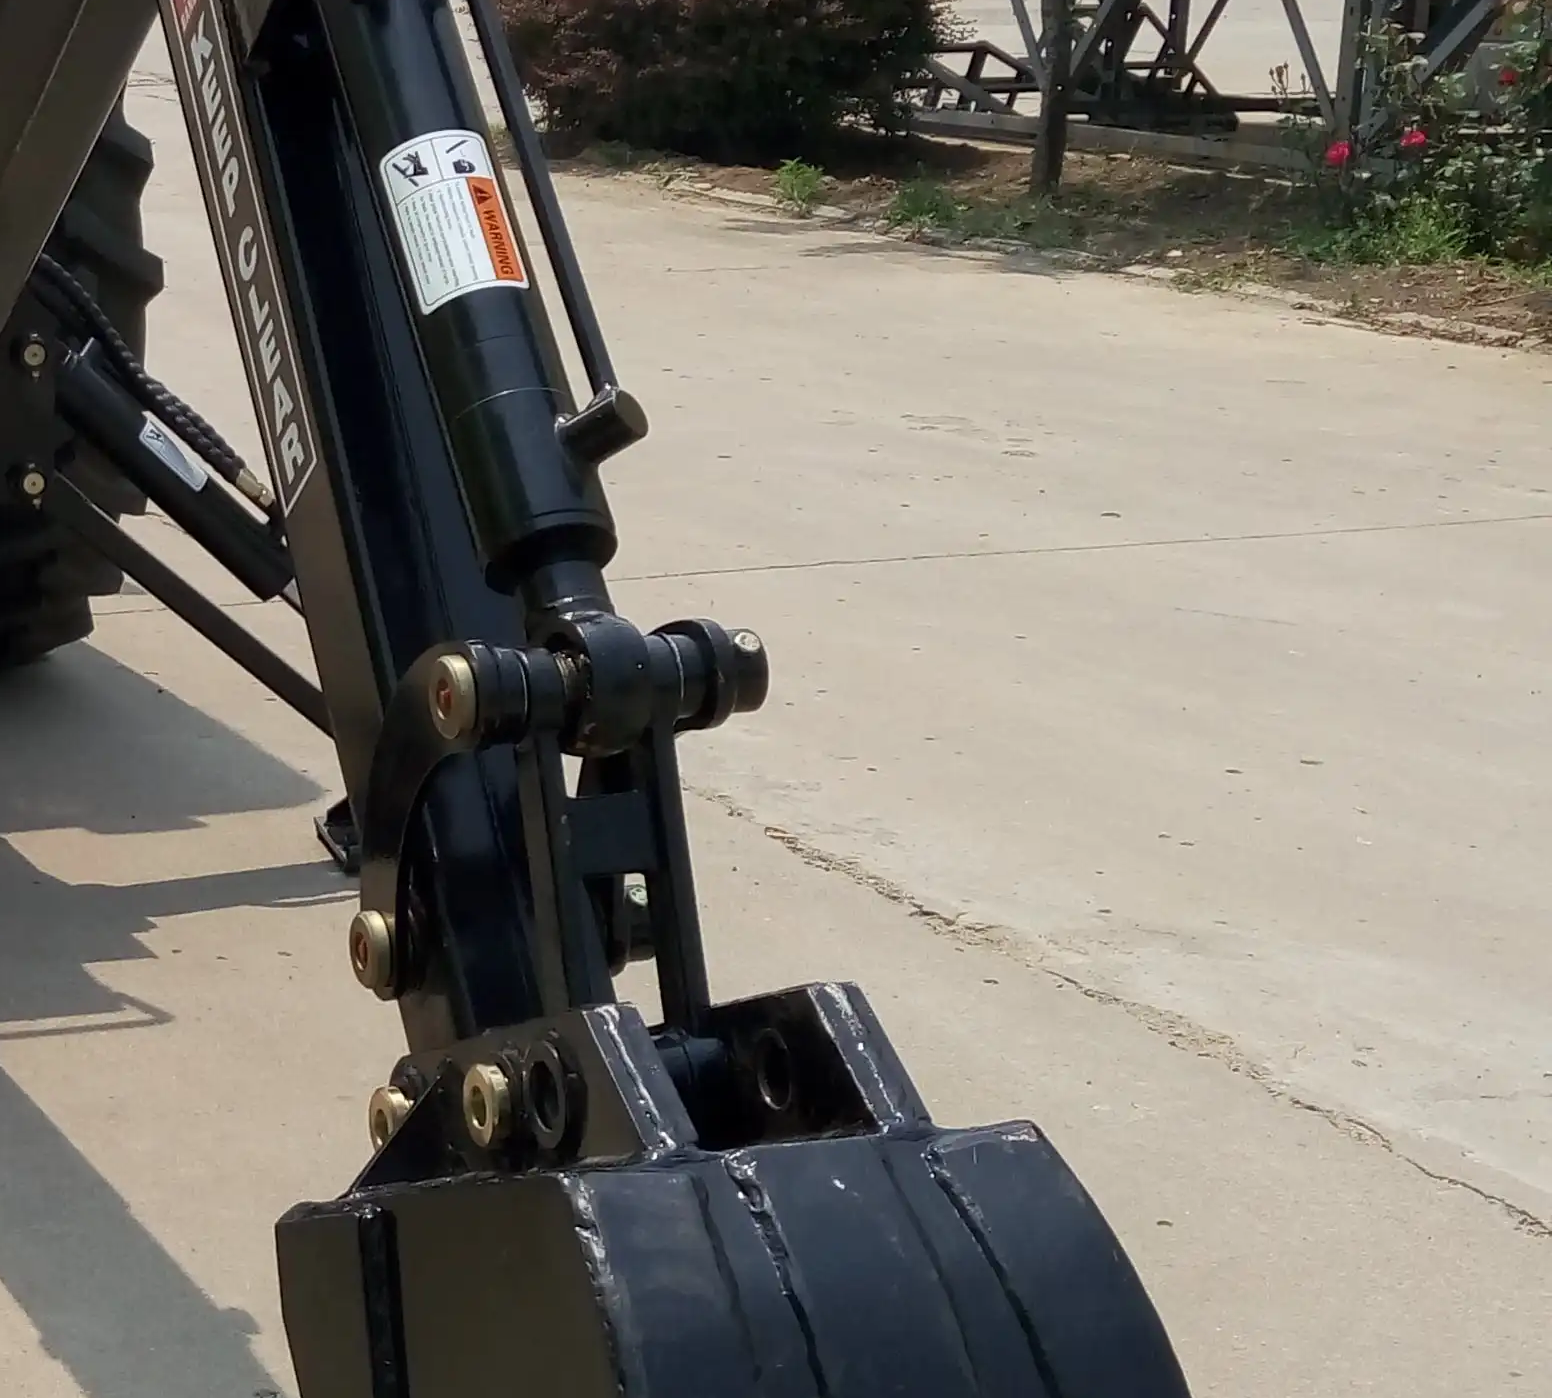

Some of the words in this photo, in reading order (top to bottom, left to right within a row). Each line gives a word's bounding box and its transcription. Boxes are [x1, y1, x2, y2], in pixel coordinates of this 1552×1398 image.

[190, 10, 240, 218] KEEP
[237, 225, 306, 485] CLEAR
[483, 208, 515, 276] WARNING
